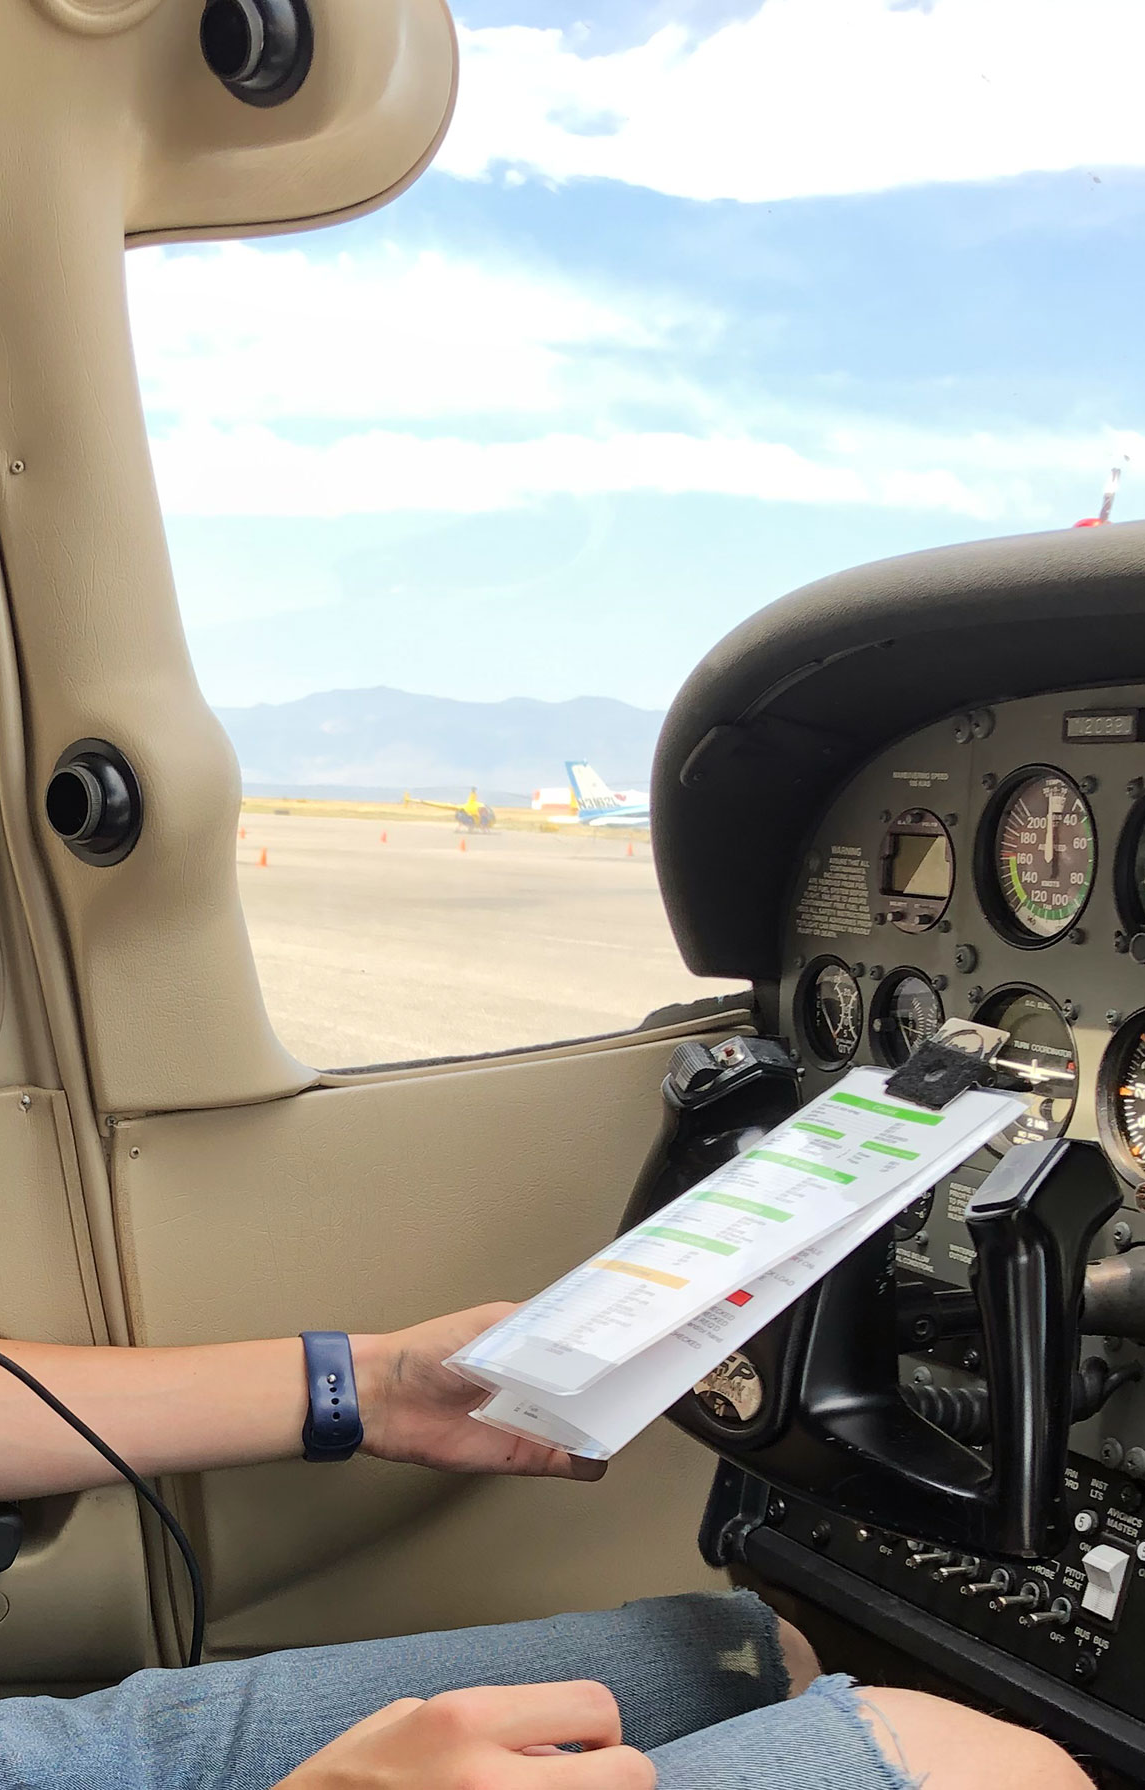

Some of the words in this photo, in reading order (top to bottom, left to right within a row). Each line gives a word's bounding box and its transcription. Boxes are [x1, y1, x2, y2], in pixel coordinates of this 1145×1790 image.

[1027, 816, 1047, 830] 200
[1063, 814, 1078, 826] 40
[1020, 831, 1037, 844] 180
[1072, 837, 1087, 850] 60
[1017, 852, 1033, 865] 160
[1021, 871, 1038, 884] 140
[1070, 872, 1084, 885] 80
[1031, 890, 1048, 903] 120
[1051, 893, 1069, 906] 100
[1013, 1040, 1030, 1050] TURN
[1031, 1043, 1072, 1059] COORDINATOR
[1026, 1117, 1033, 1127] 2
[710, 1305, 735, 1321] ECKED
[1090, 1478, 1109, 1491] INST
[1089, 1488, 1104, 1501] LTS
[1078, 1516, 1085, 1528] 5
[1107, 1507, 1143, 1528] AVIONICS
[1106, 1518, 1139, 1538] MASTER
[1027, 1564, 1056, 1581] ROBE
[1065, 1566, 1086, 1582] PITOT
[1062, 1576, 1083, 1592] HEAT
[1049, 1631, 1066, 1644] OFF
[1074, 1626, 1091, 1641] BUS
[1077, 1639, 1083, 1647] 1
[1093, 1635, 1110, 1650] BUS
[1095, 1647, 1102, 1657] 2
